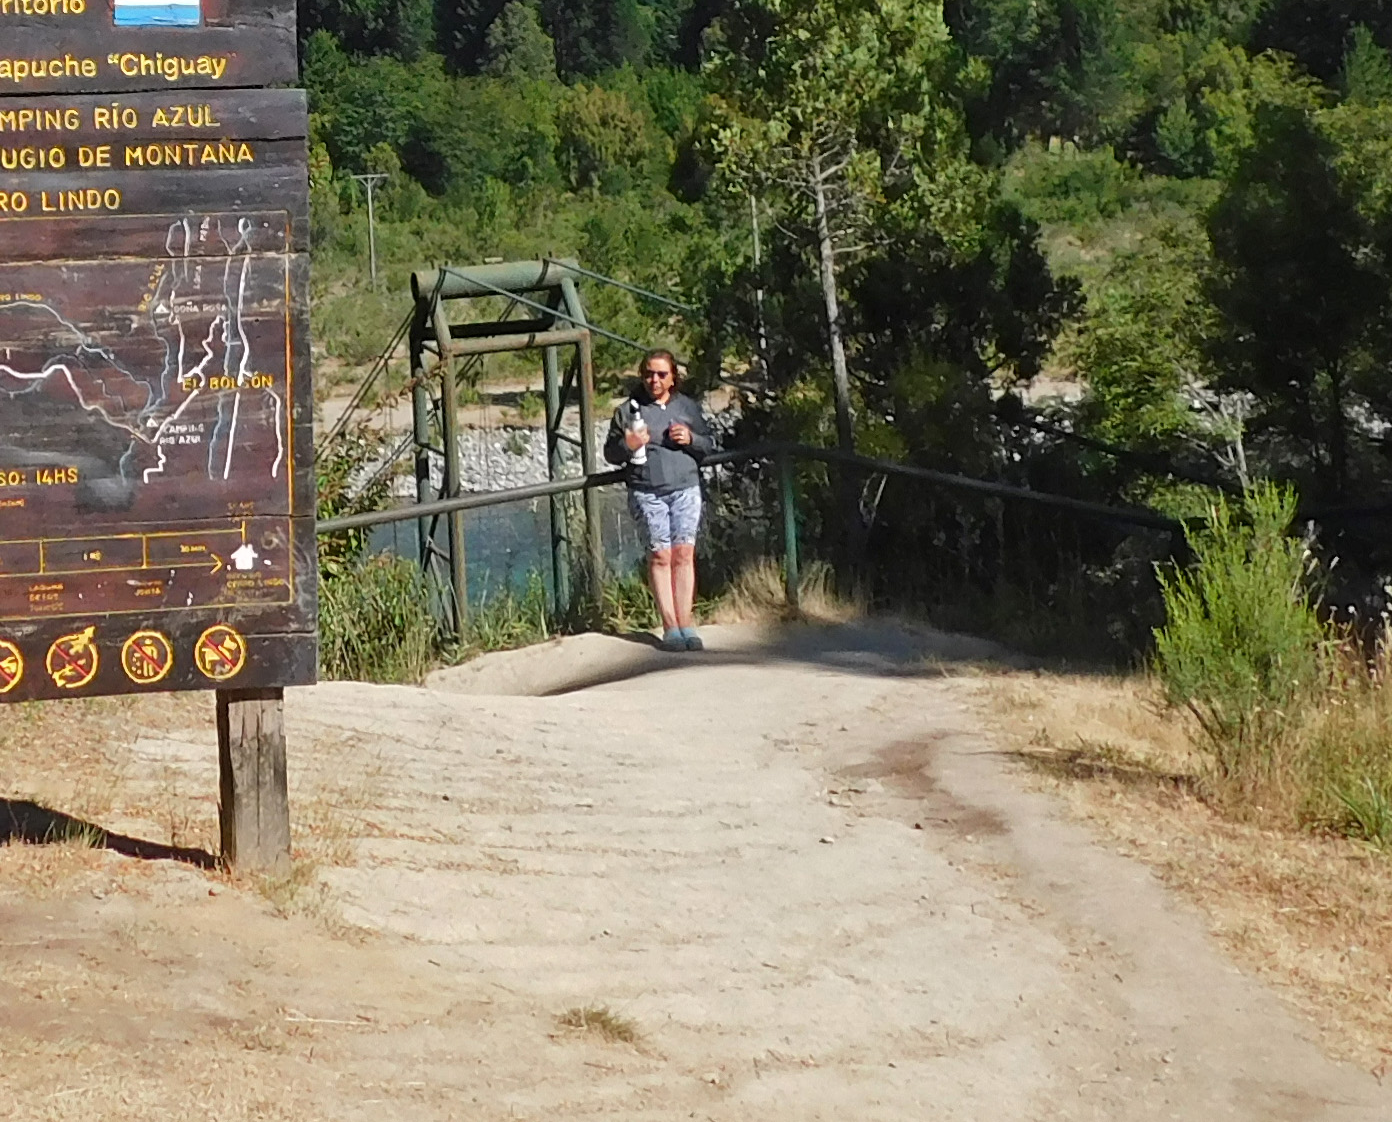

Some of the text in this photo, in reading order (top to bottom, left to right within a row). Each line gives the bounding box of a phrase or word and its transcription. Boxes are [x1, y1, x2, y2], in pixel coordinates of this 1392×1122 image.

[94, 103, 137, 129] RÍO
[152, 104, 220, 127] AZUL
[78, 146, 111, 167] DE
[41, 189, 120, 212] LINDO
